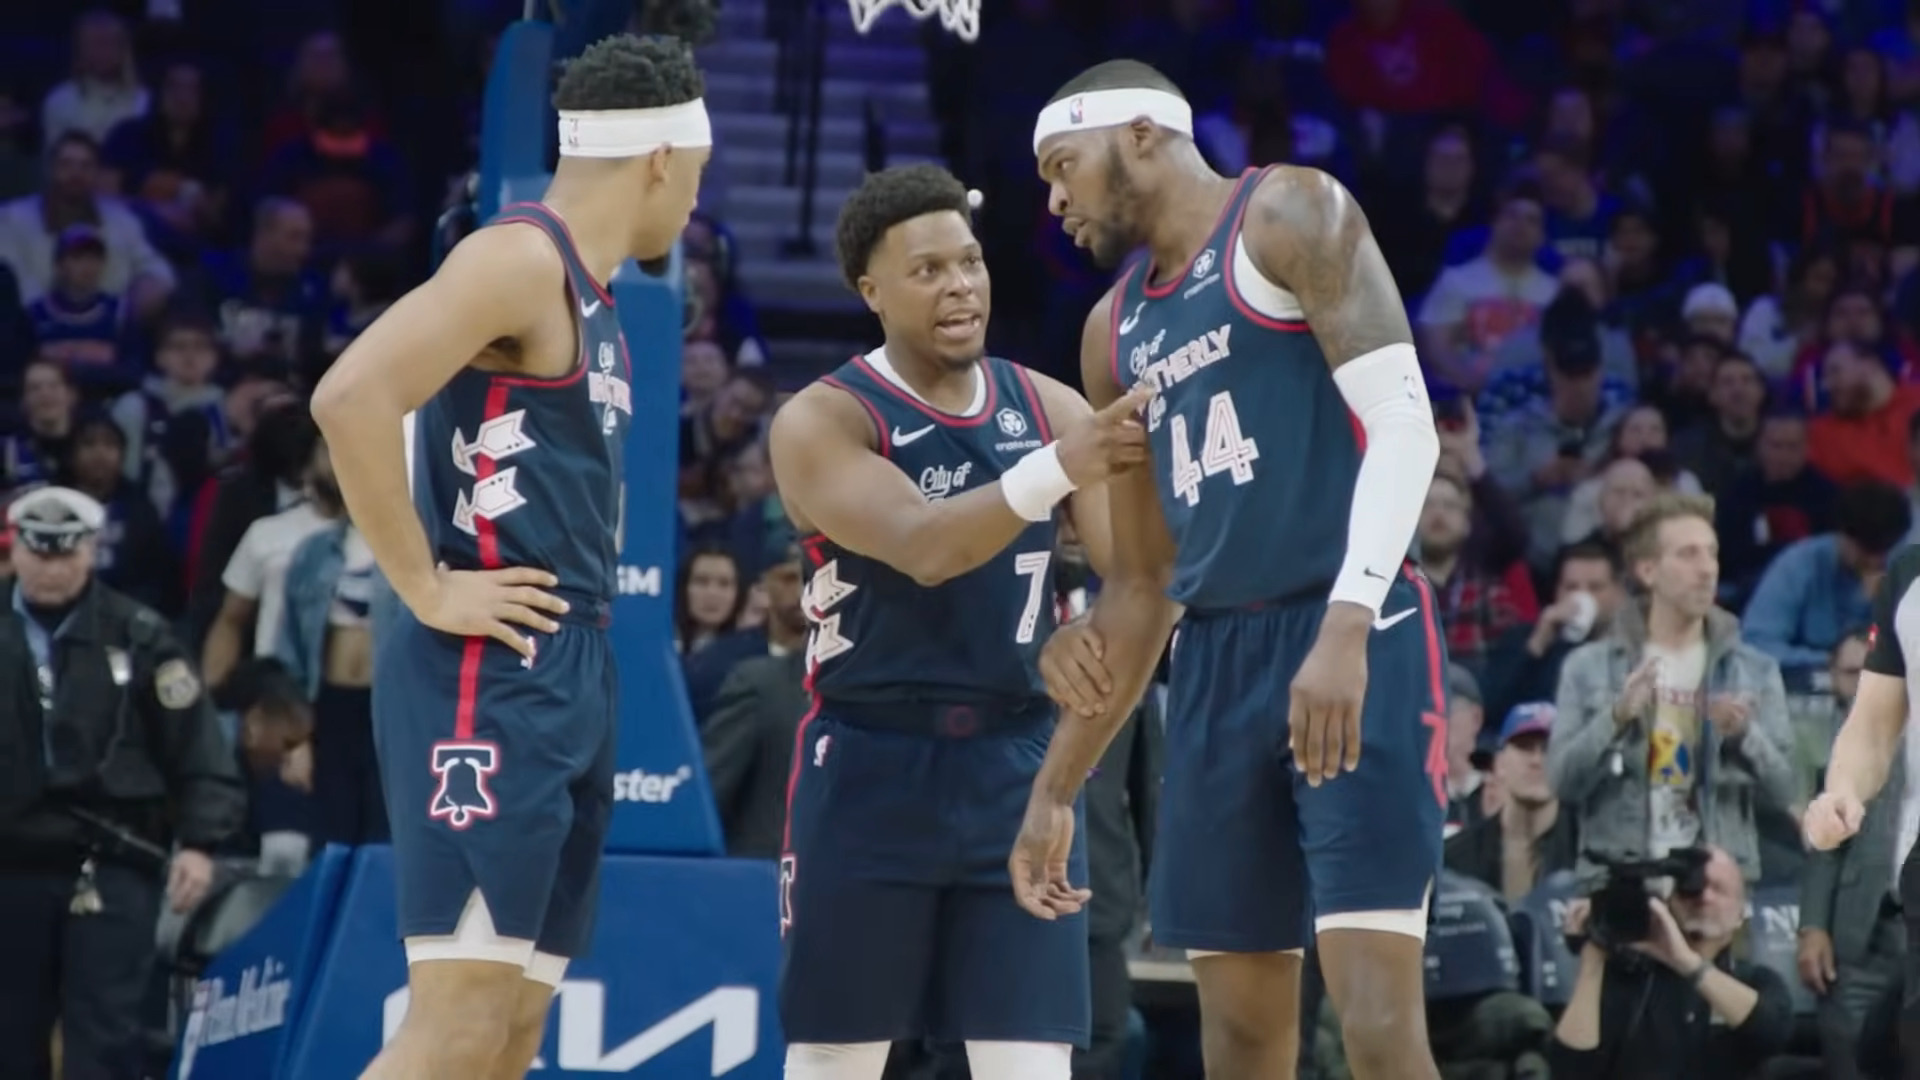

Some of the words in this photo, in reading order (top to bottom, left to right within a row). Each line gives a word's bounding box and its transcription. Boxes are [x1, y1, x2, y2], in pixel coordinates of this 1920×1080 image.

[1144, 324, 1231, 393] THERLY
[1170, 390, 1260, 507] 44
[1014, 550, 1052, 643] 7
